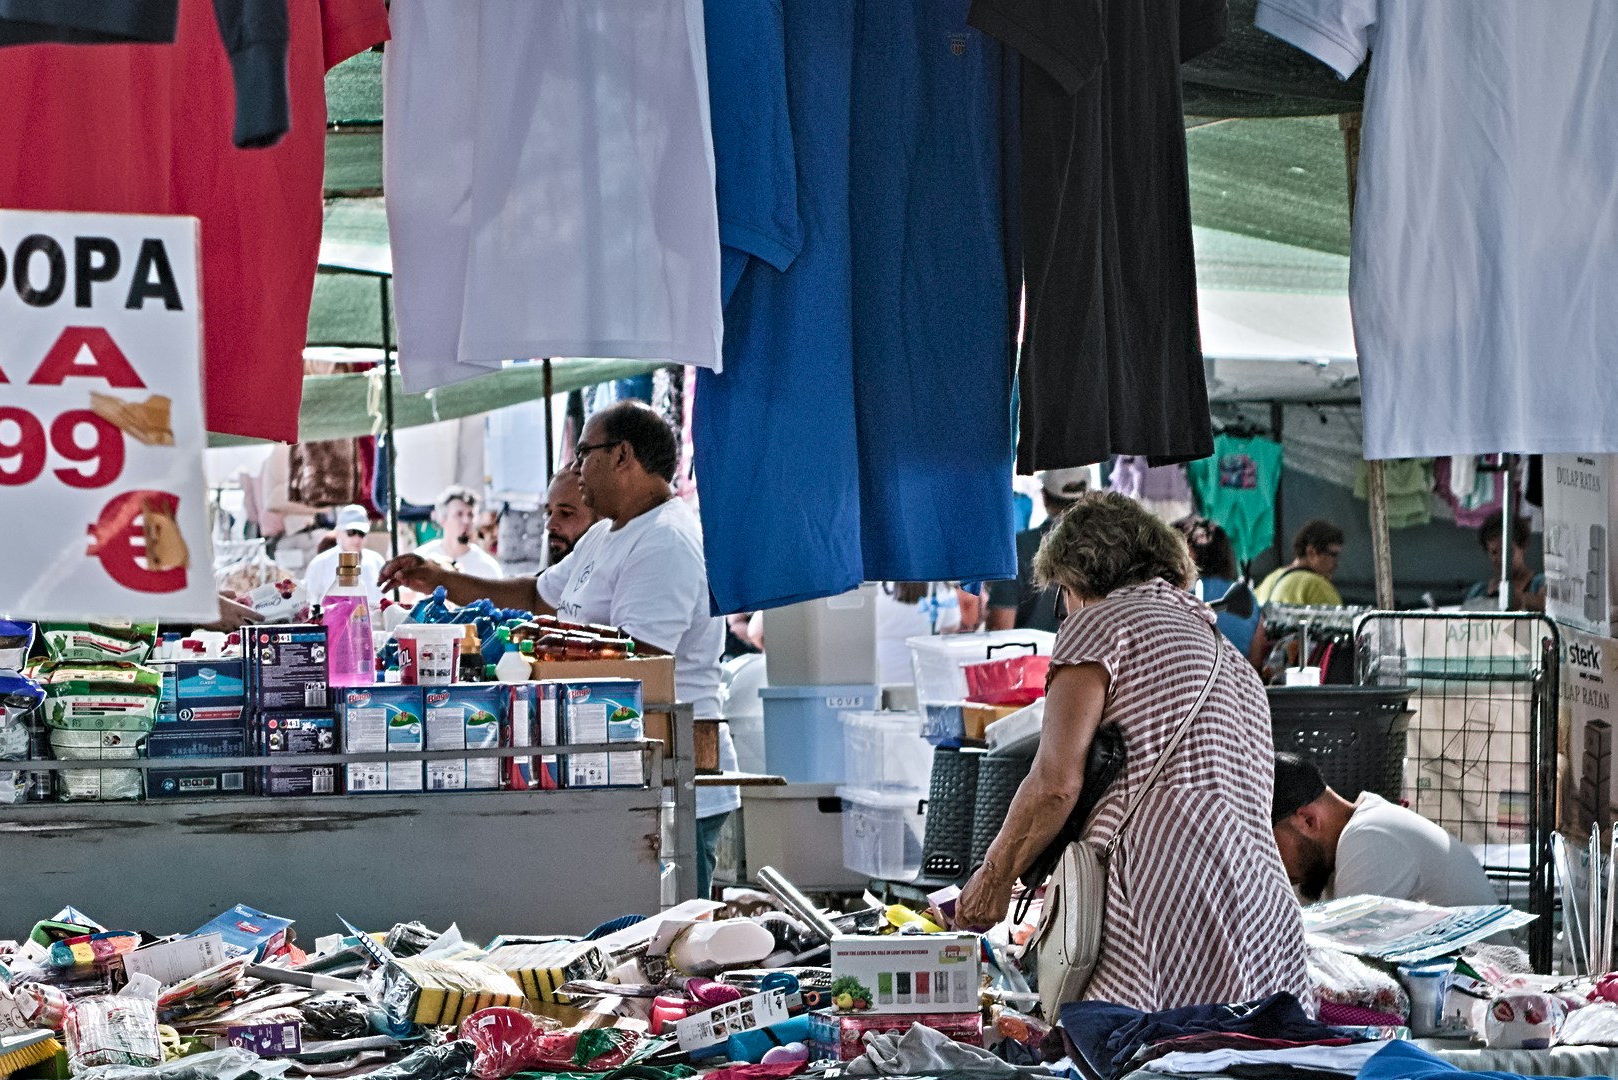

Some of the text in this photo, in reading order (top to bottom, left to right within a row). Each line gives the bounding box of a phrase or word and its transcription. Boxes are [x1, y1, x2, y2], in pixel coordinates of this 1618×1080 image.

[1569, 642, 1600, 670] sterk
[348, 692, 371, 704] Bingo
[427, 691, 450, 703] Bingo
[568, 687, 591, 699] Bingo
[1582, 687, 1610, 709] RATAN
[829, 697, 860, 706] LOVE
